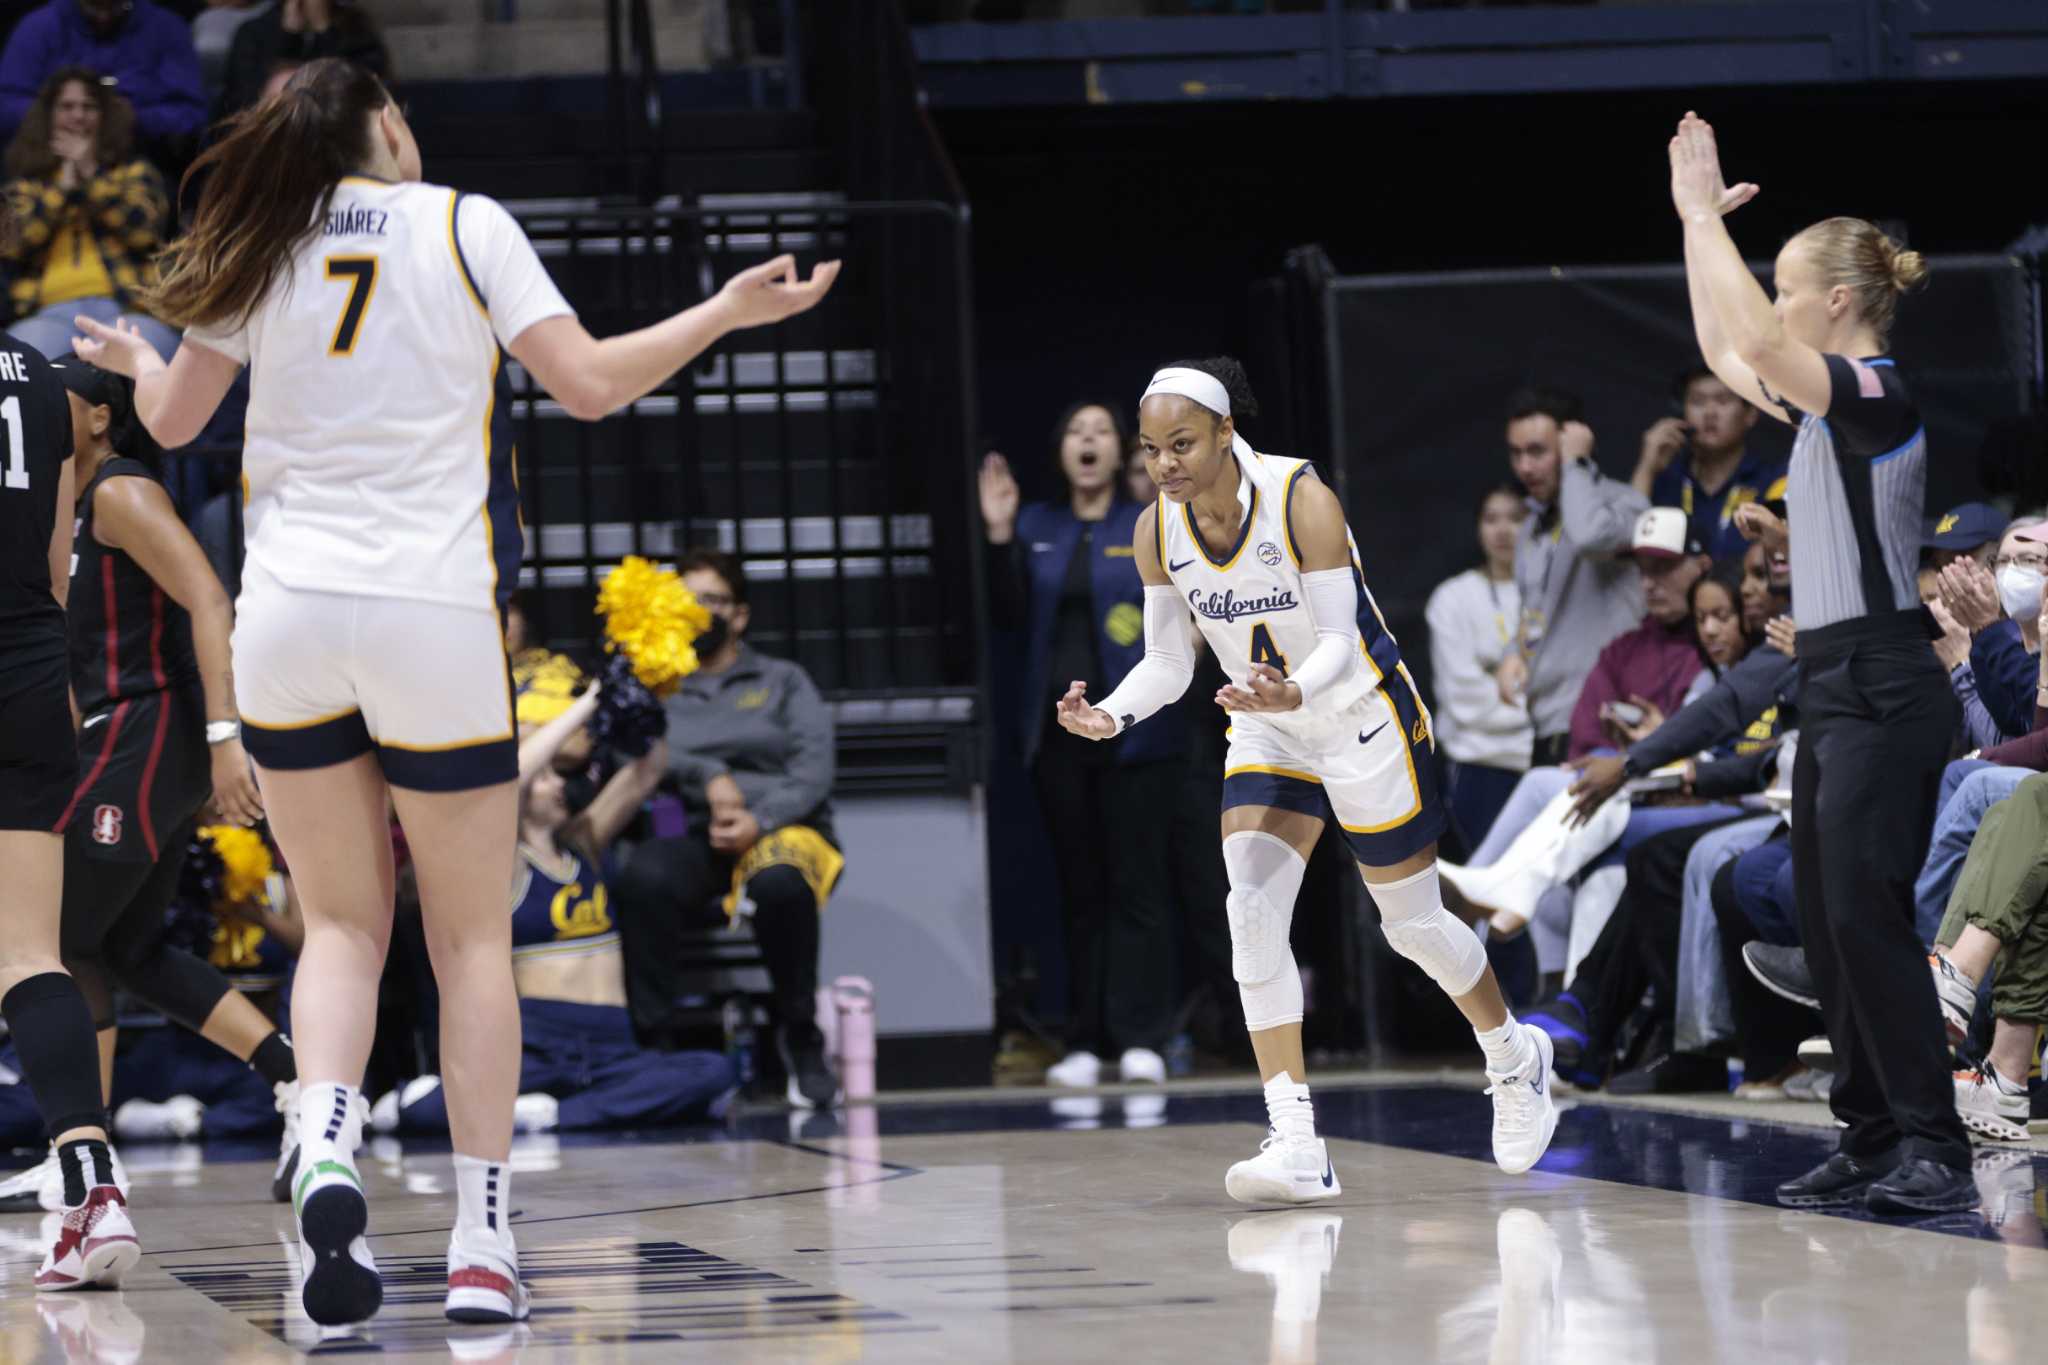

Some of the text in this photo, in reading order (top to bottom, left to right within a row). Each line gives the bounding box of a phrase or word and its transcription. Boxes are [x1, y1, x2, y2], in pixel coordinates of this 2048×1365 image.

[323, 202, 388, 236] SUÁREZ
[324, 256, 379, 357] 7
[1188, 588, 1298, 623] California
[1249, 620, 1289, 679] 4
[550, 881, 611, 938] Cal
